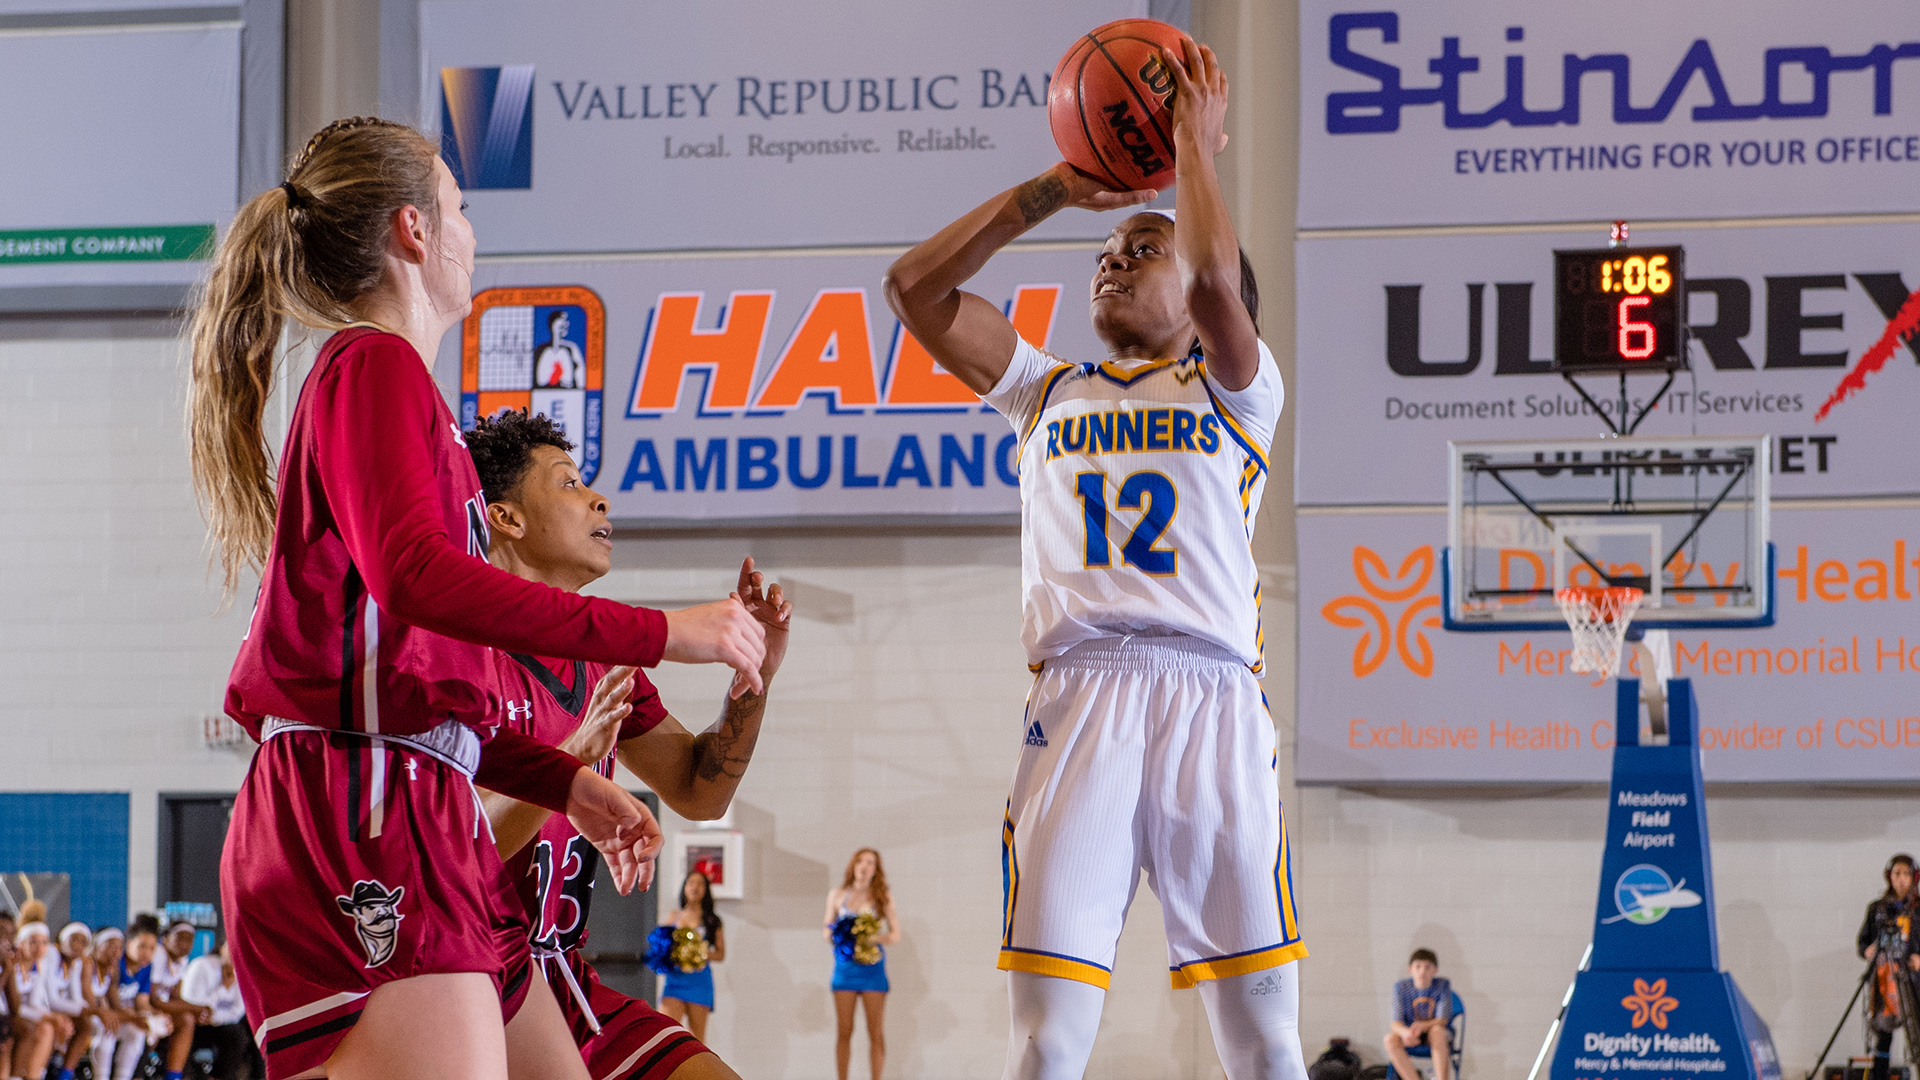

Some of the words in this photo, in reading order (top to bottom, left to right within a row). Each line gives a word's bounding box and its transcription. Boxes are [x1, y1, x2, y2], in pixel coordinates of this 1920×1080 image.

[553, 81, 717, 120] VALLEY
[735, 75, 959, 119] REPUBLIC
[980, 67, 1052, 108] BA
[663, 134, 732, 160] Local.
[747, 132, 881, 164] Responsive.
[897, 126, 997, 154] Reliable.
[1103, 100, 1166, 178] NCAA
[1454, 145, 1643, 174] EVERYTHING
[1652, 142, 1712, 169] FOR
[1721, 139, 1807, 167] YOUR
[1815, 135, 1920, 164] OFFICE
[71, 235, 166, 255] COMPANY
[1602, 255, 1672, 295] 1:06
[1618, 296, 1656, 359] 6
[1384, 397, 1515, 420] Document
[1667, 391, 1689, 414] IT
[1698, 390, 1803, 414] Services
[1045, 407, 1222, 465] RUNNERS
[619, 433, 1020, 492] AMBULANC
[1074, 469, 1180, 577] 12
[1675, 635, 1862, 676] Memorial
[1348, 718, 1479, 750] Exclusive
[1489, 719, 1581, 750] Health
[1796, 718, 1825, 749] of
[1618, 789, 1688, 807] Meadows
[1631, 810, 1671, 827] Field
[1623, 831, 1676, 850] Airport
[1583, 1032, 1652, 1057] Dignity
[1574, 1057, 1609, 1073] Mercy
[1610, 1057, 1621, 1070] &
[1622, 1057, 1674, 1071] Memorial
[1674, 1057, 1727, 1074] Hospitals
